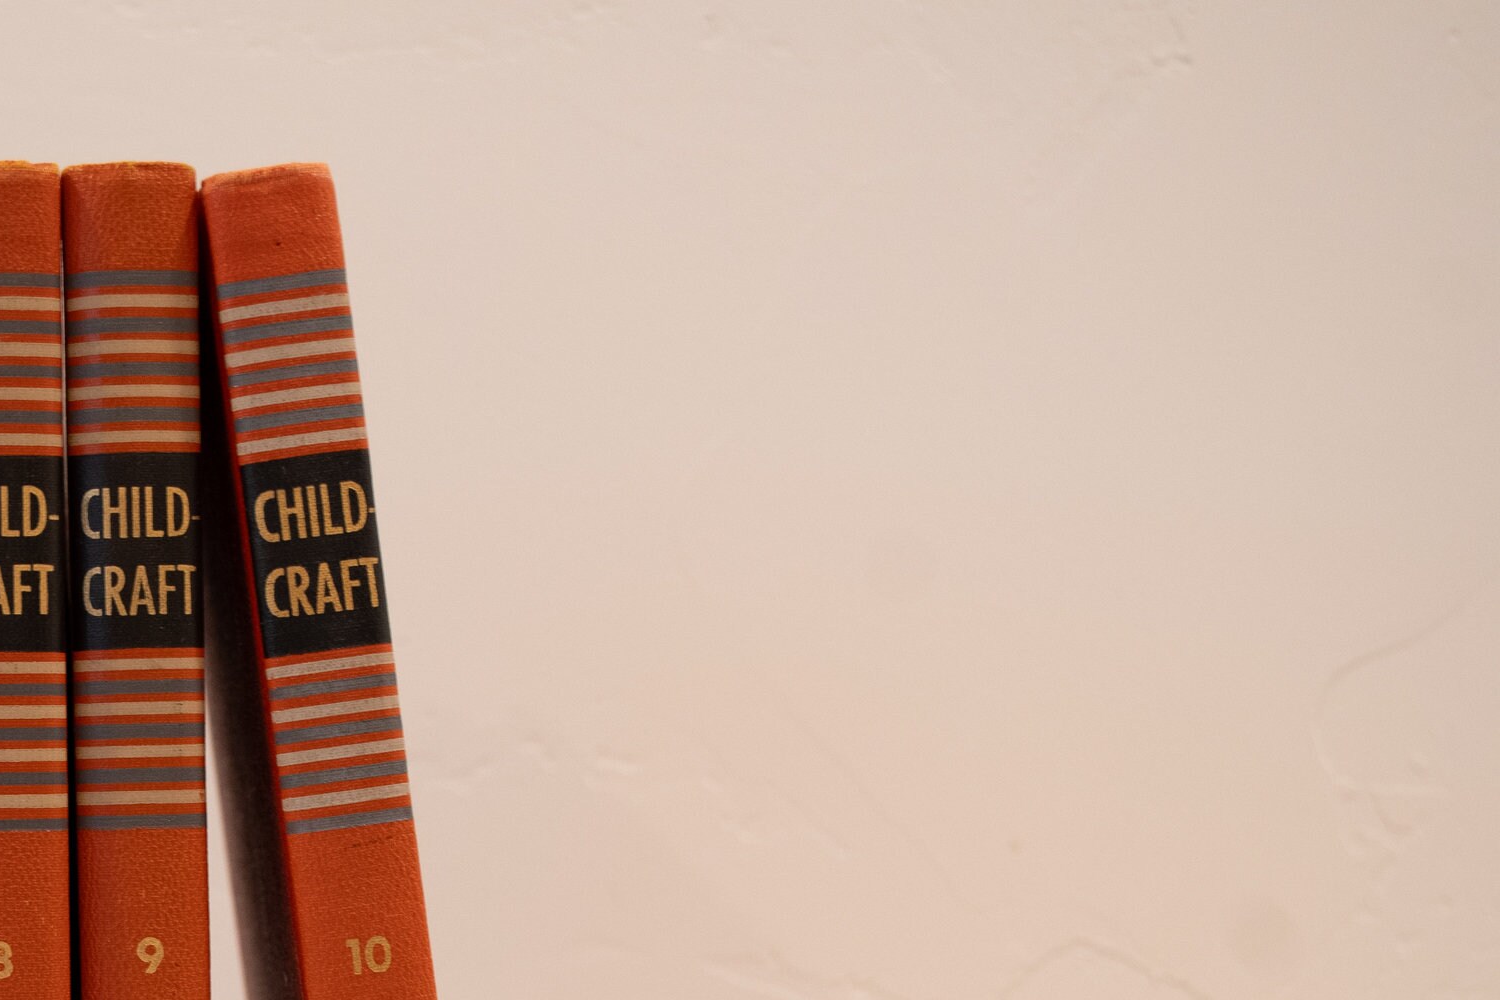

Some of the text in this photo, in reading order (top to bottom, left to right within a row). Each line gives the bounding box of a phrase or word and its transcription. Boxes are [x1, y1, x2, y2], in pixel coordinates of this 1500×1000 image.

[80, 485, 200, 539] CHILD-
[82, 564, 197, 617] CRAFT
[264, 556, 379, 618] CRAFT
[135, 936, 164, 974] 9
[345, 935, 392, 975] 10
